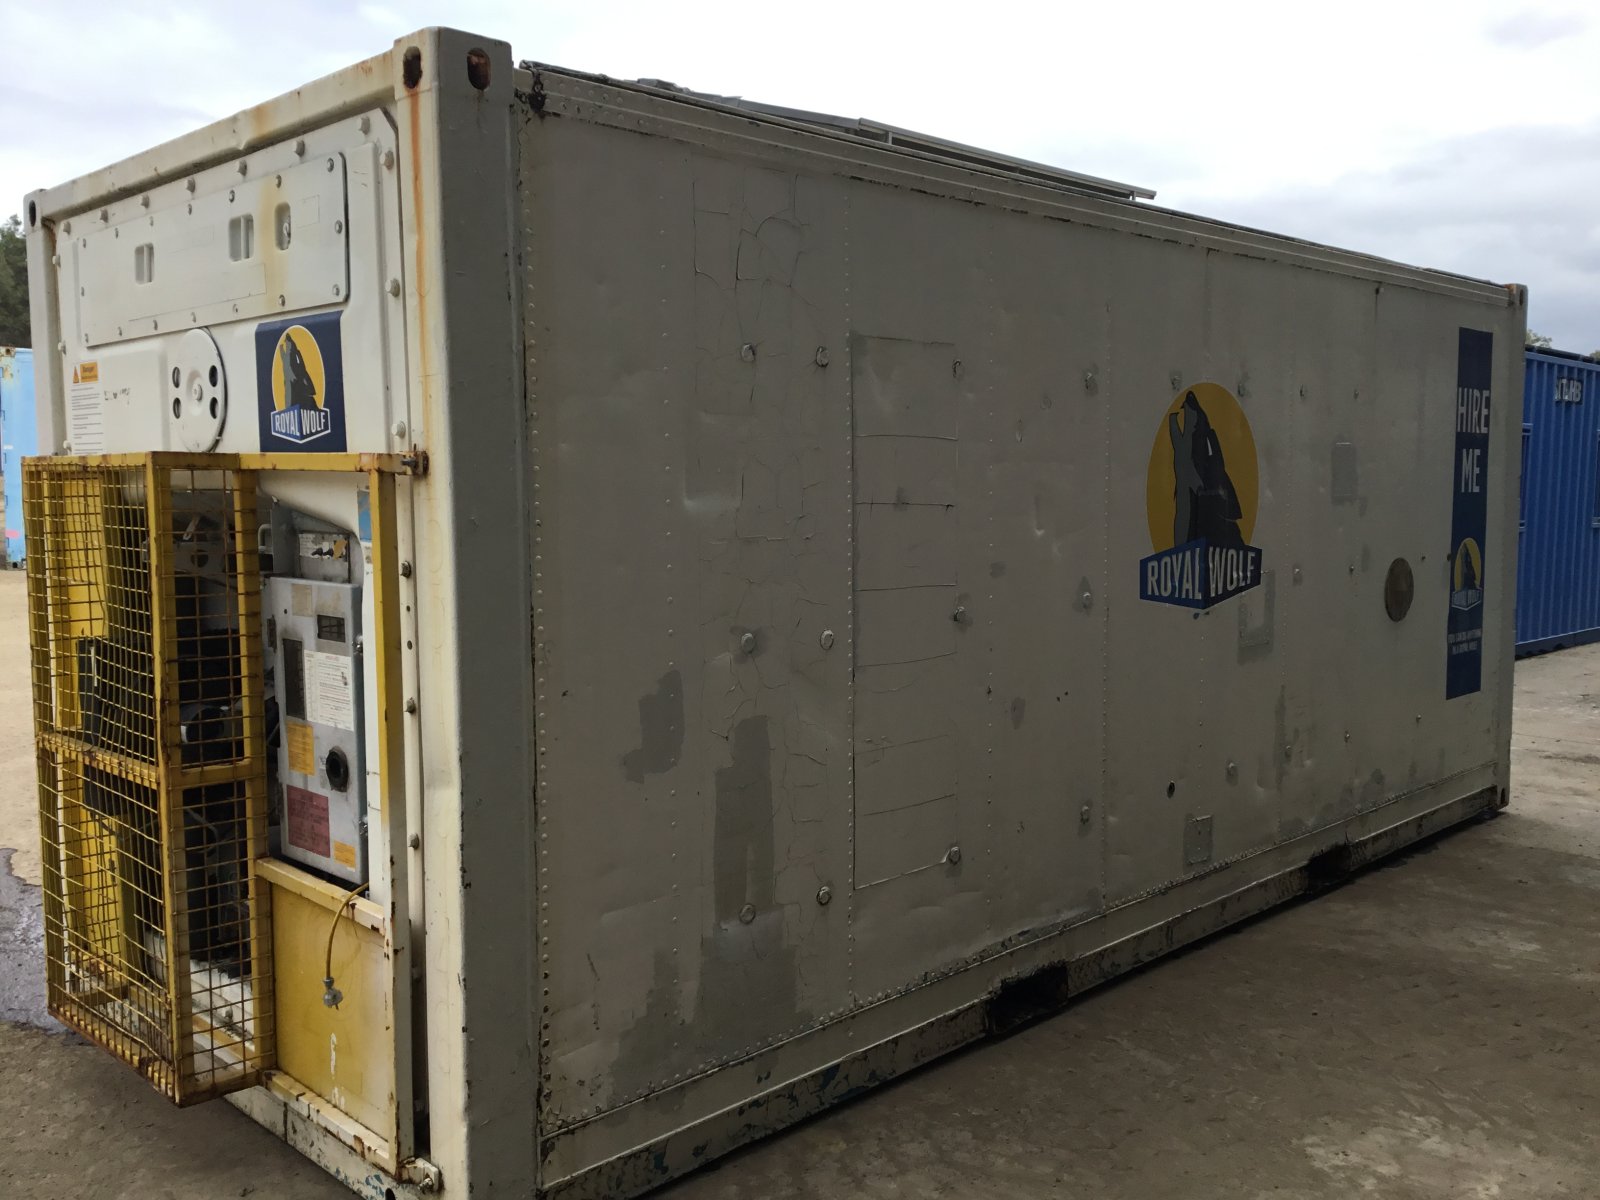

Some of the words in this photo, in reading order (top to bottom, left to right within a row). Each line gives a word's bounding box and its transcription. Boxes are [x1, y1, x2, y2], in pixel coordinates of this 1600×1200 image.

[275, 409, 300, 436] ROYAL
[301, 408, 325, 435] WOLF
[1457, 387, 1490, 434] HIRE
[1461, 448, 1481, 493] ME
[1147, 547, 1202, 600] ROYAL
[1208, 546, 1256, 597] WOLF
